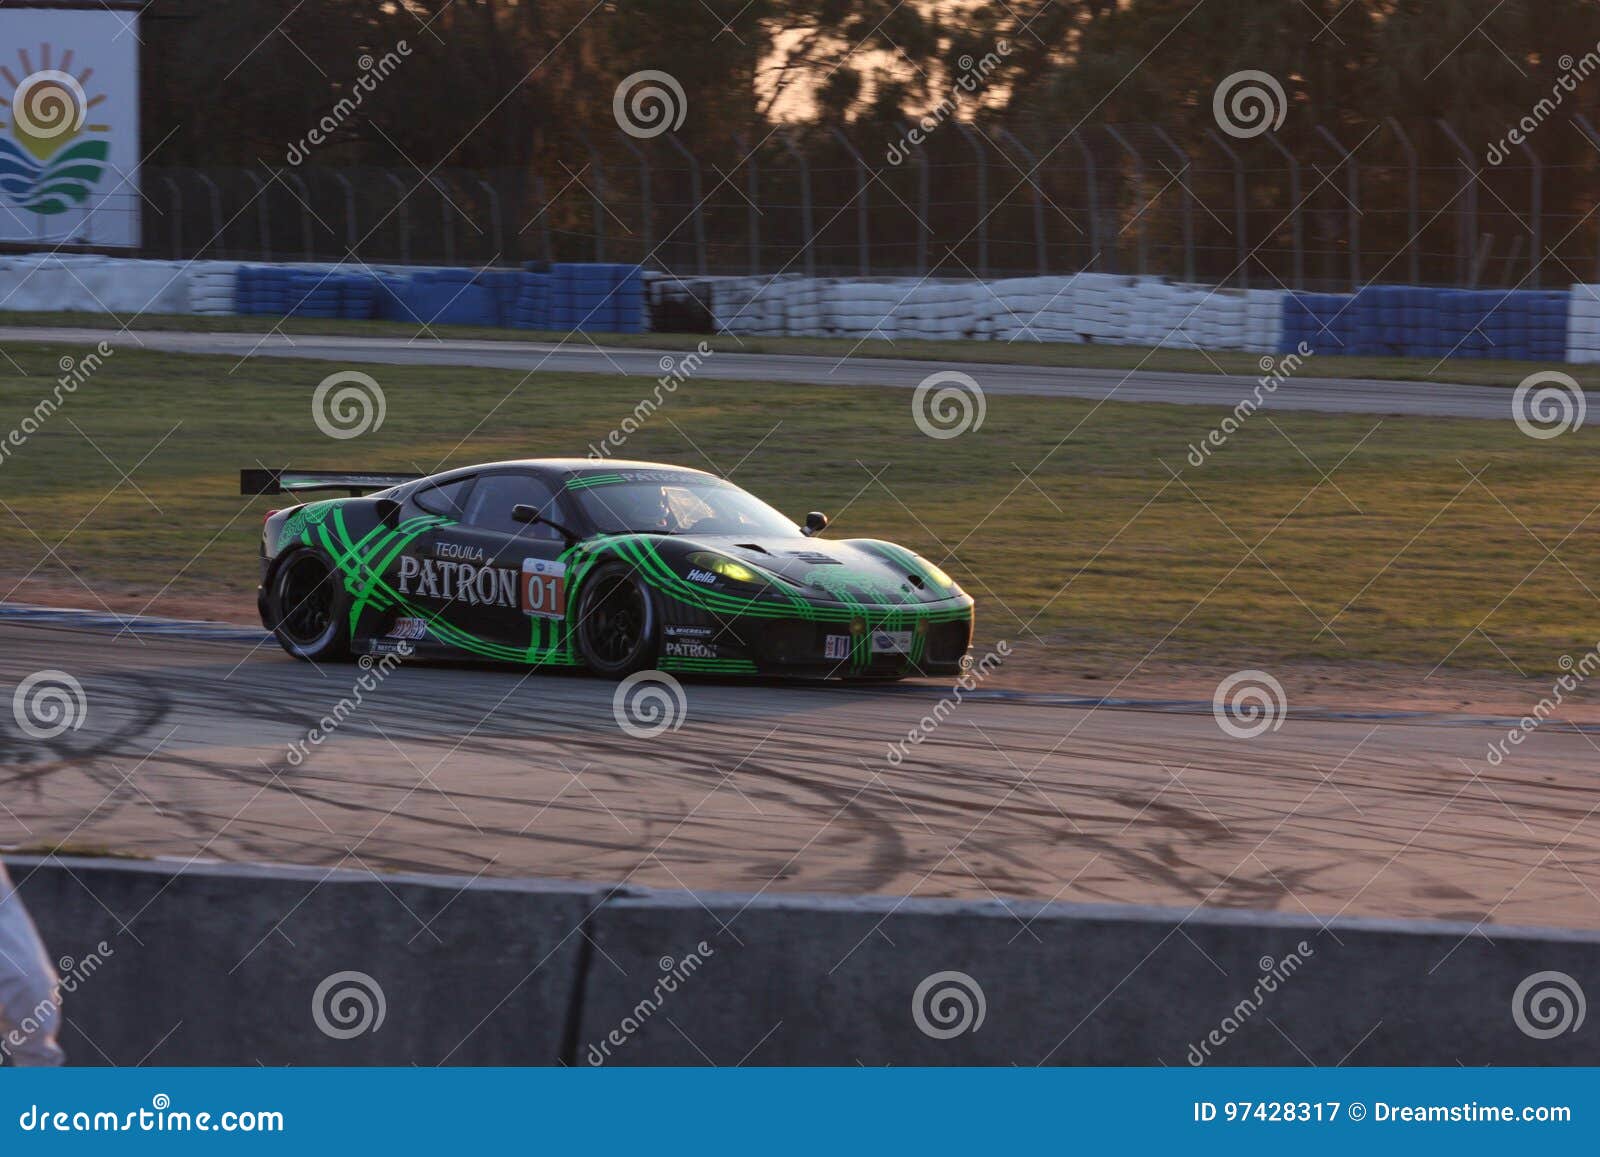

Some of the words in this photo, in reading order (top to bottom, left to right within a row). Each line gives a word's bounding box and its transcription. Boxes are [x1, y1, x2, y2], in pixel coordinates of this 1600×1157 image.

[436, 542, 484, 560] TEQUILA
[398, 556, 518, 608] PATRÓN
[686, 569, 717, 584] Hella
[528, 575, 557, 611] 01
